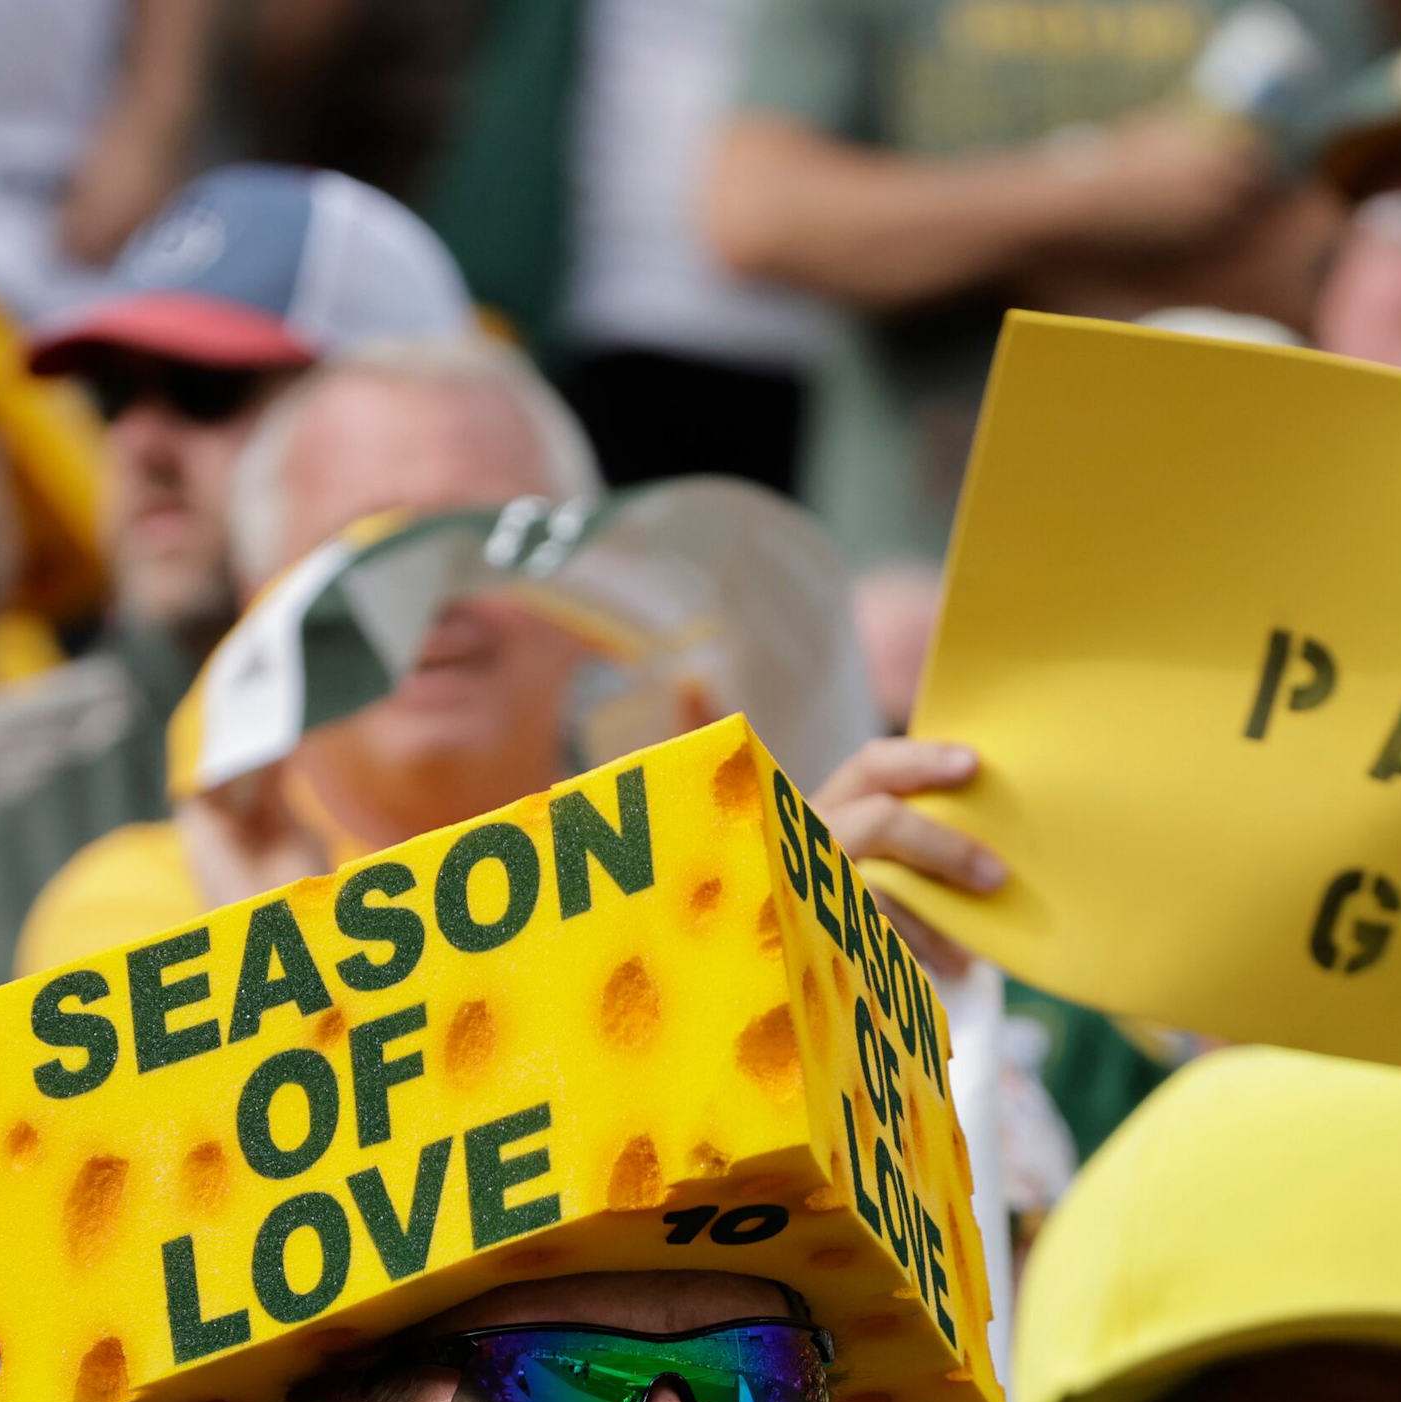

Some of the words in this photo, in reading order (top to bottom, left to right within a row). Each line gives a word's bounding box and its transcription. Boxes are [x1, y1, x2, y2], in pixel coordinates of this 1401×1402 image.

[30, 766, 655, 1100] SEASON
[772, 768, 946, 1100] SEASON
[236, 1002, 428, 1181] OF
[854, 994, 905, 1158] OF
[161, 1102, 563, 1365] LOVE
[662, 1203, 790, 1246] 10
[841, 1091, 958, 1350] LOVE
